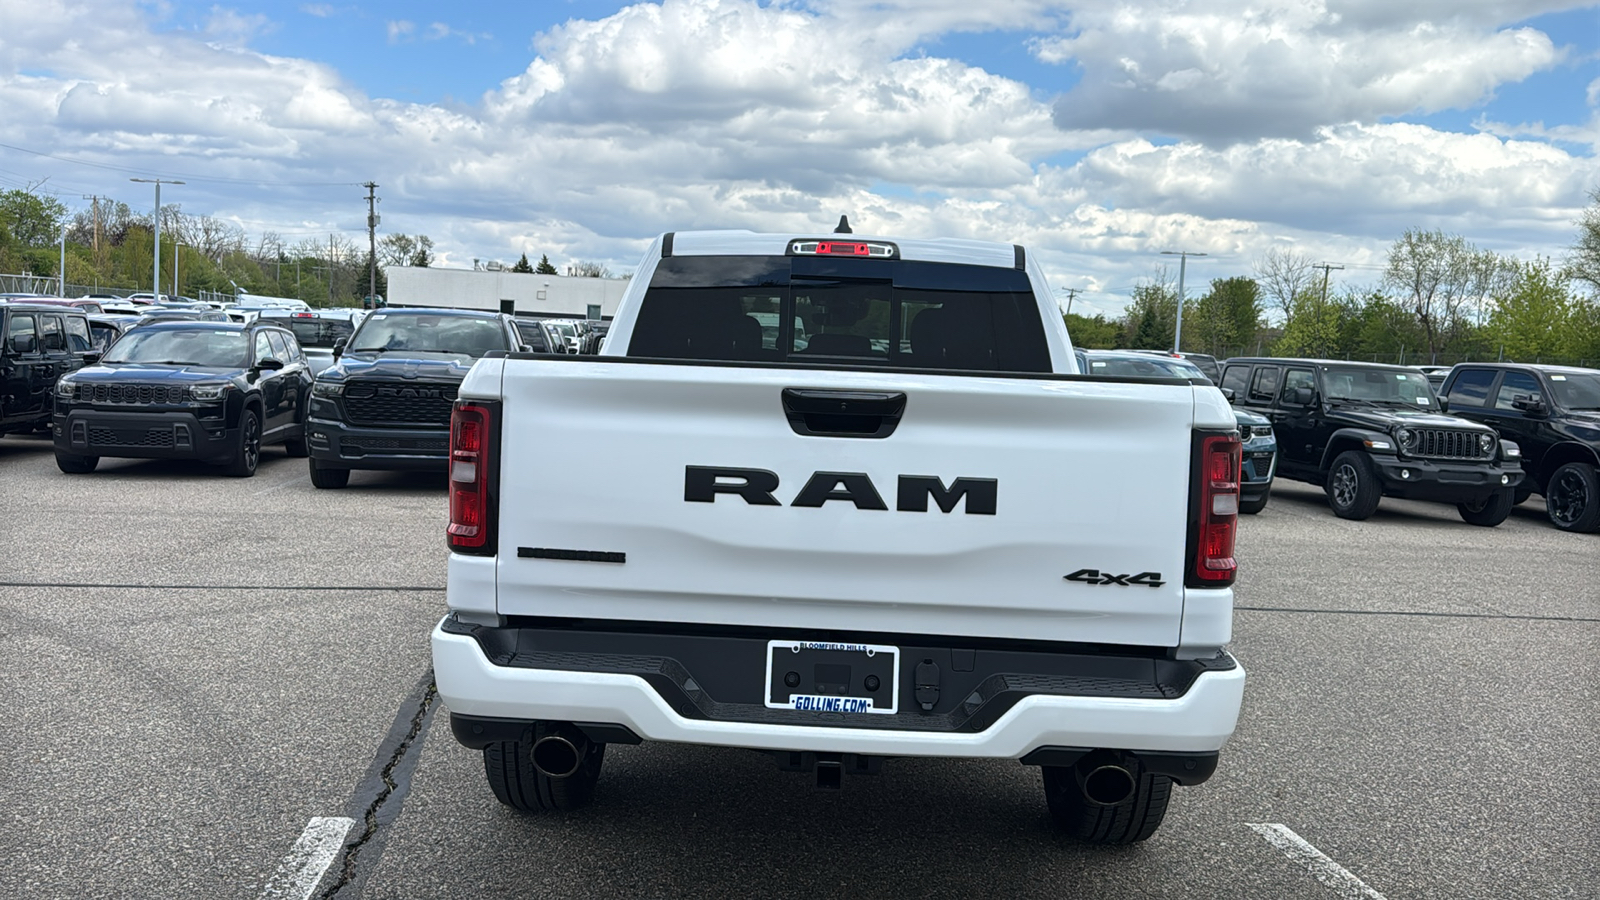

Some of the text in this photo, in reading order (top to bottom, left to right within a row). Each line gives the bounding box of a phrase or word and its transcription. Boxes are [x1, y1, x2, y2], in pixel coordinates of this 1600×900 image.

[378, 388, 439, 398] RAM
[684, 465, 998, 515] RAM
[1063, 569, 1166, 587] 4x4
[800, 642, 845, 651] BLOOMFIELD
[795, 696, 867, 713] GOLLING.COM
